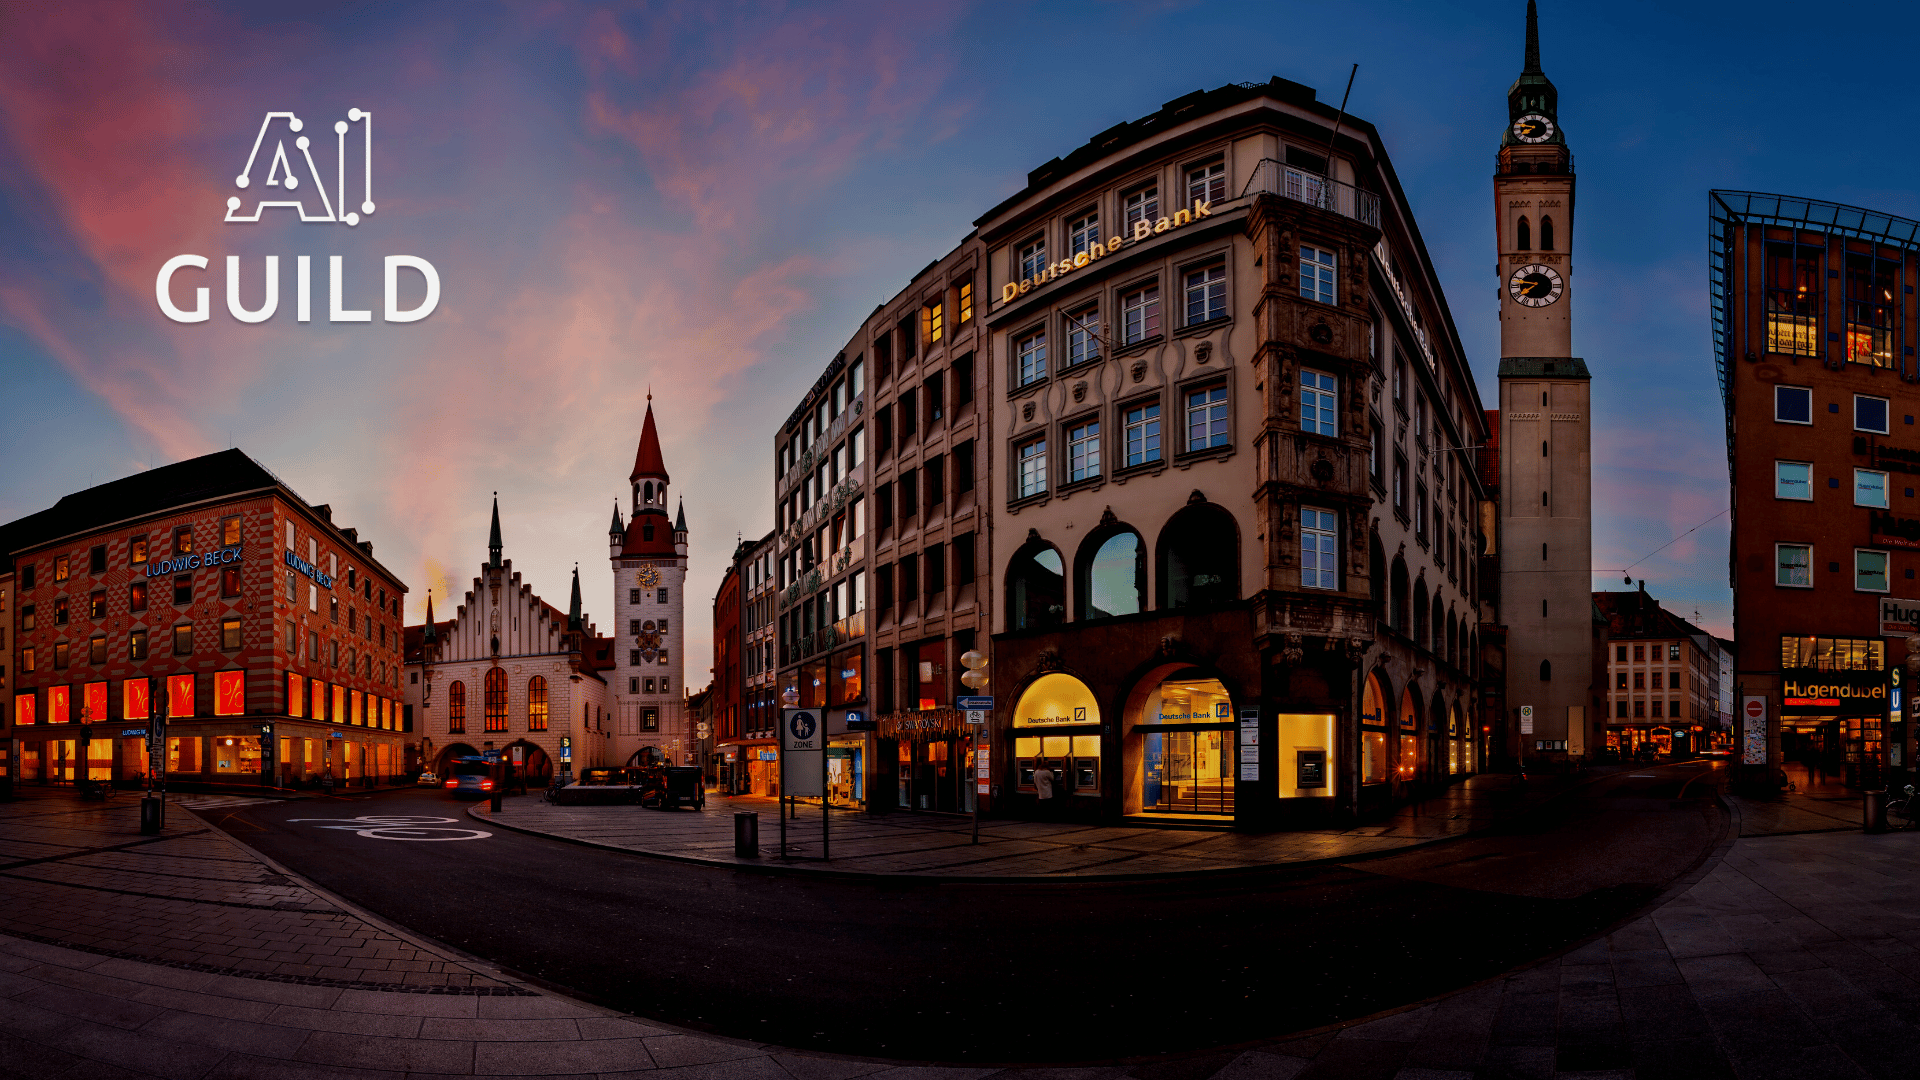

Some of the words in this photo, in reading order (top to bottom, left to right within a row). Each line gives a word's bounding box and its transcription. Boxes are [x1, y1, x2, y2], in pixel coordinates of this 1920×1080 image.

[1002, 235, 1123, 304] Deutsche
[1134, 199, 1213, 242] Bank
[1378, 241, 1418, 335] Deutsche
[146, 555, 201, 577] LUDWIG
[203, 547, 243, 567] BECK
[285, 550, 315, 578] LUDWIG
[316, 570, 332, 590] BECK
[1891, 667, 1900, 687] S
[1783, 680, 1887, 700] Hugendubel
[1892, 691, 1900, 708] U
[905, 719, 942, 730] SWAROVSKI
[1158, 713, 1191, 721] Deutsche
[1192, 711, 1211, 719] Bank
[793, 740, 813, 749] ZONE
